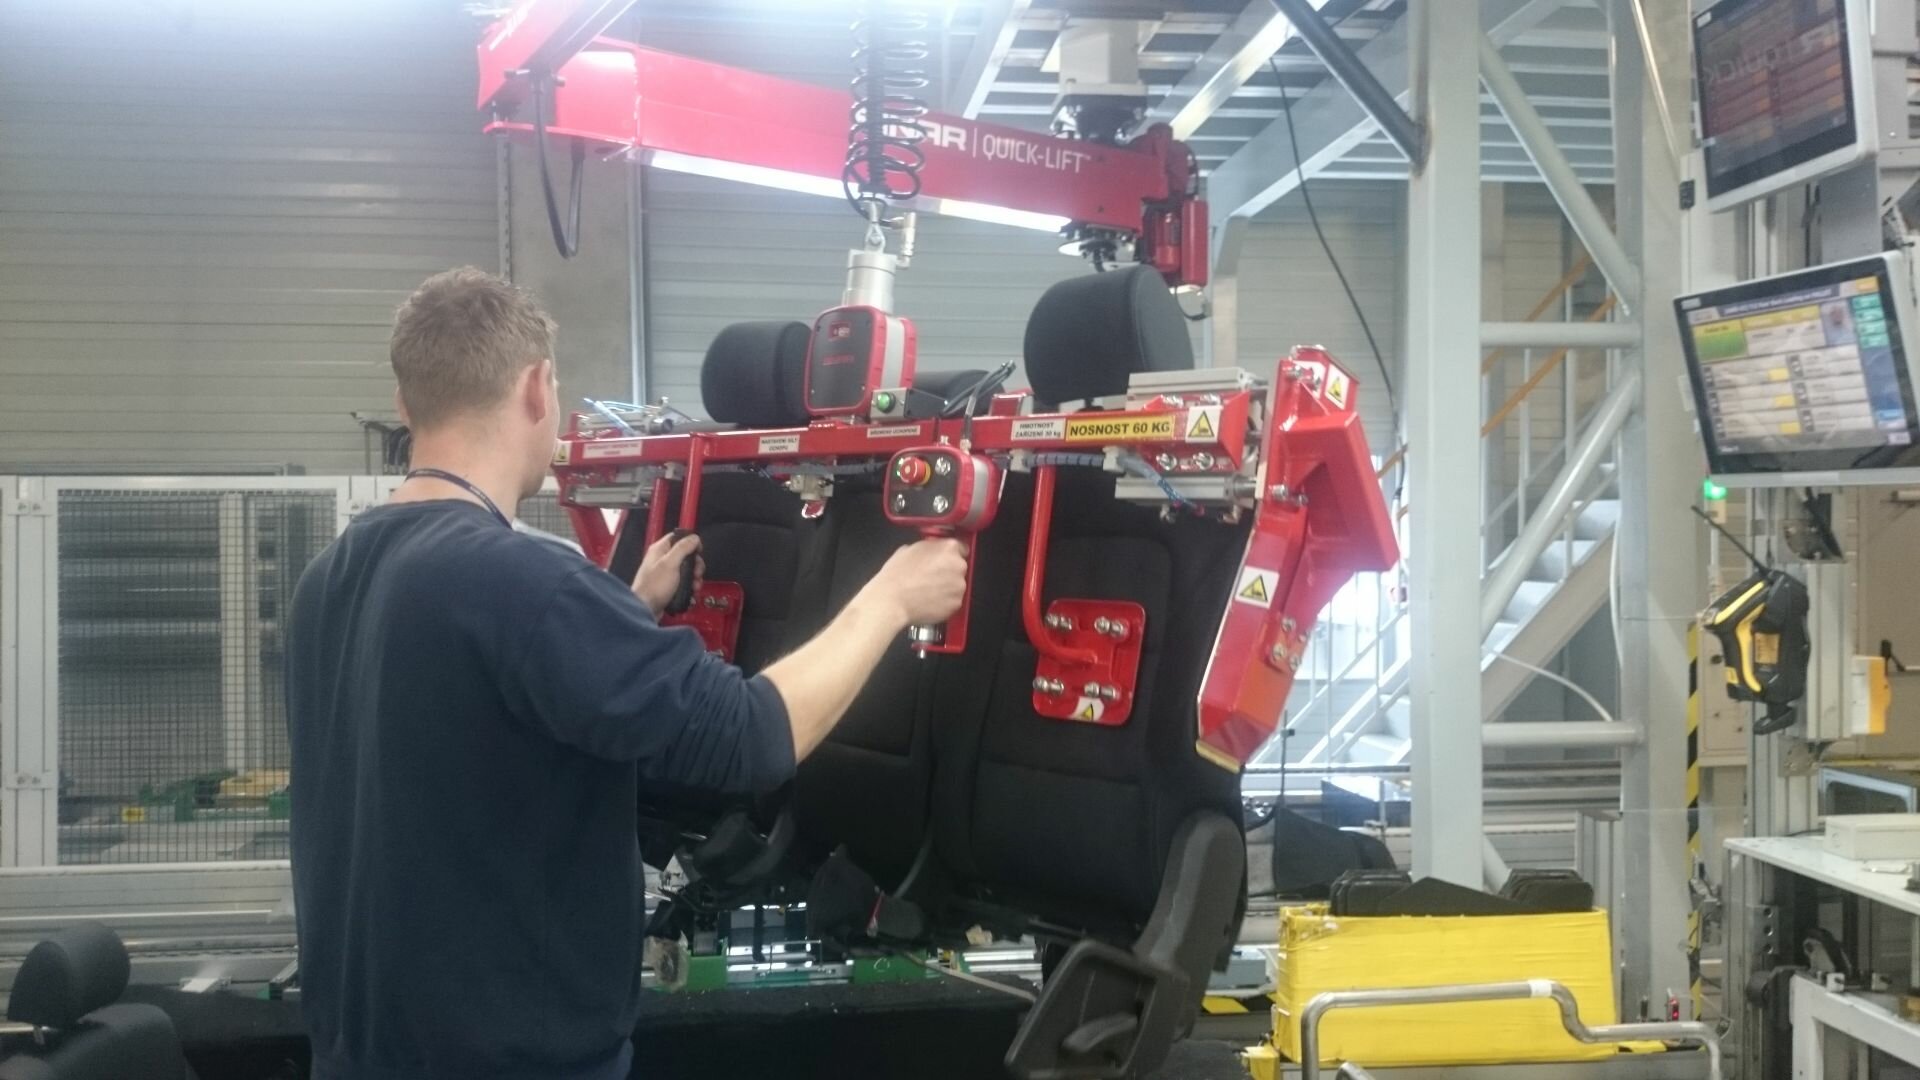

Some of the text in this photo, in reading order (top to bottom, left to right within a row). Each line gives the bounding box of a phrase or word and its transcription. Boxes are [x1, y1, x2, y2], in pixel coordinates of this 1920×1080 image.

[1019, 421, 1054, 430] HMOTNOST
[1069, 421, 1170, 436] NOSNOST 60 KG
